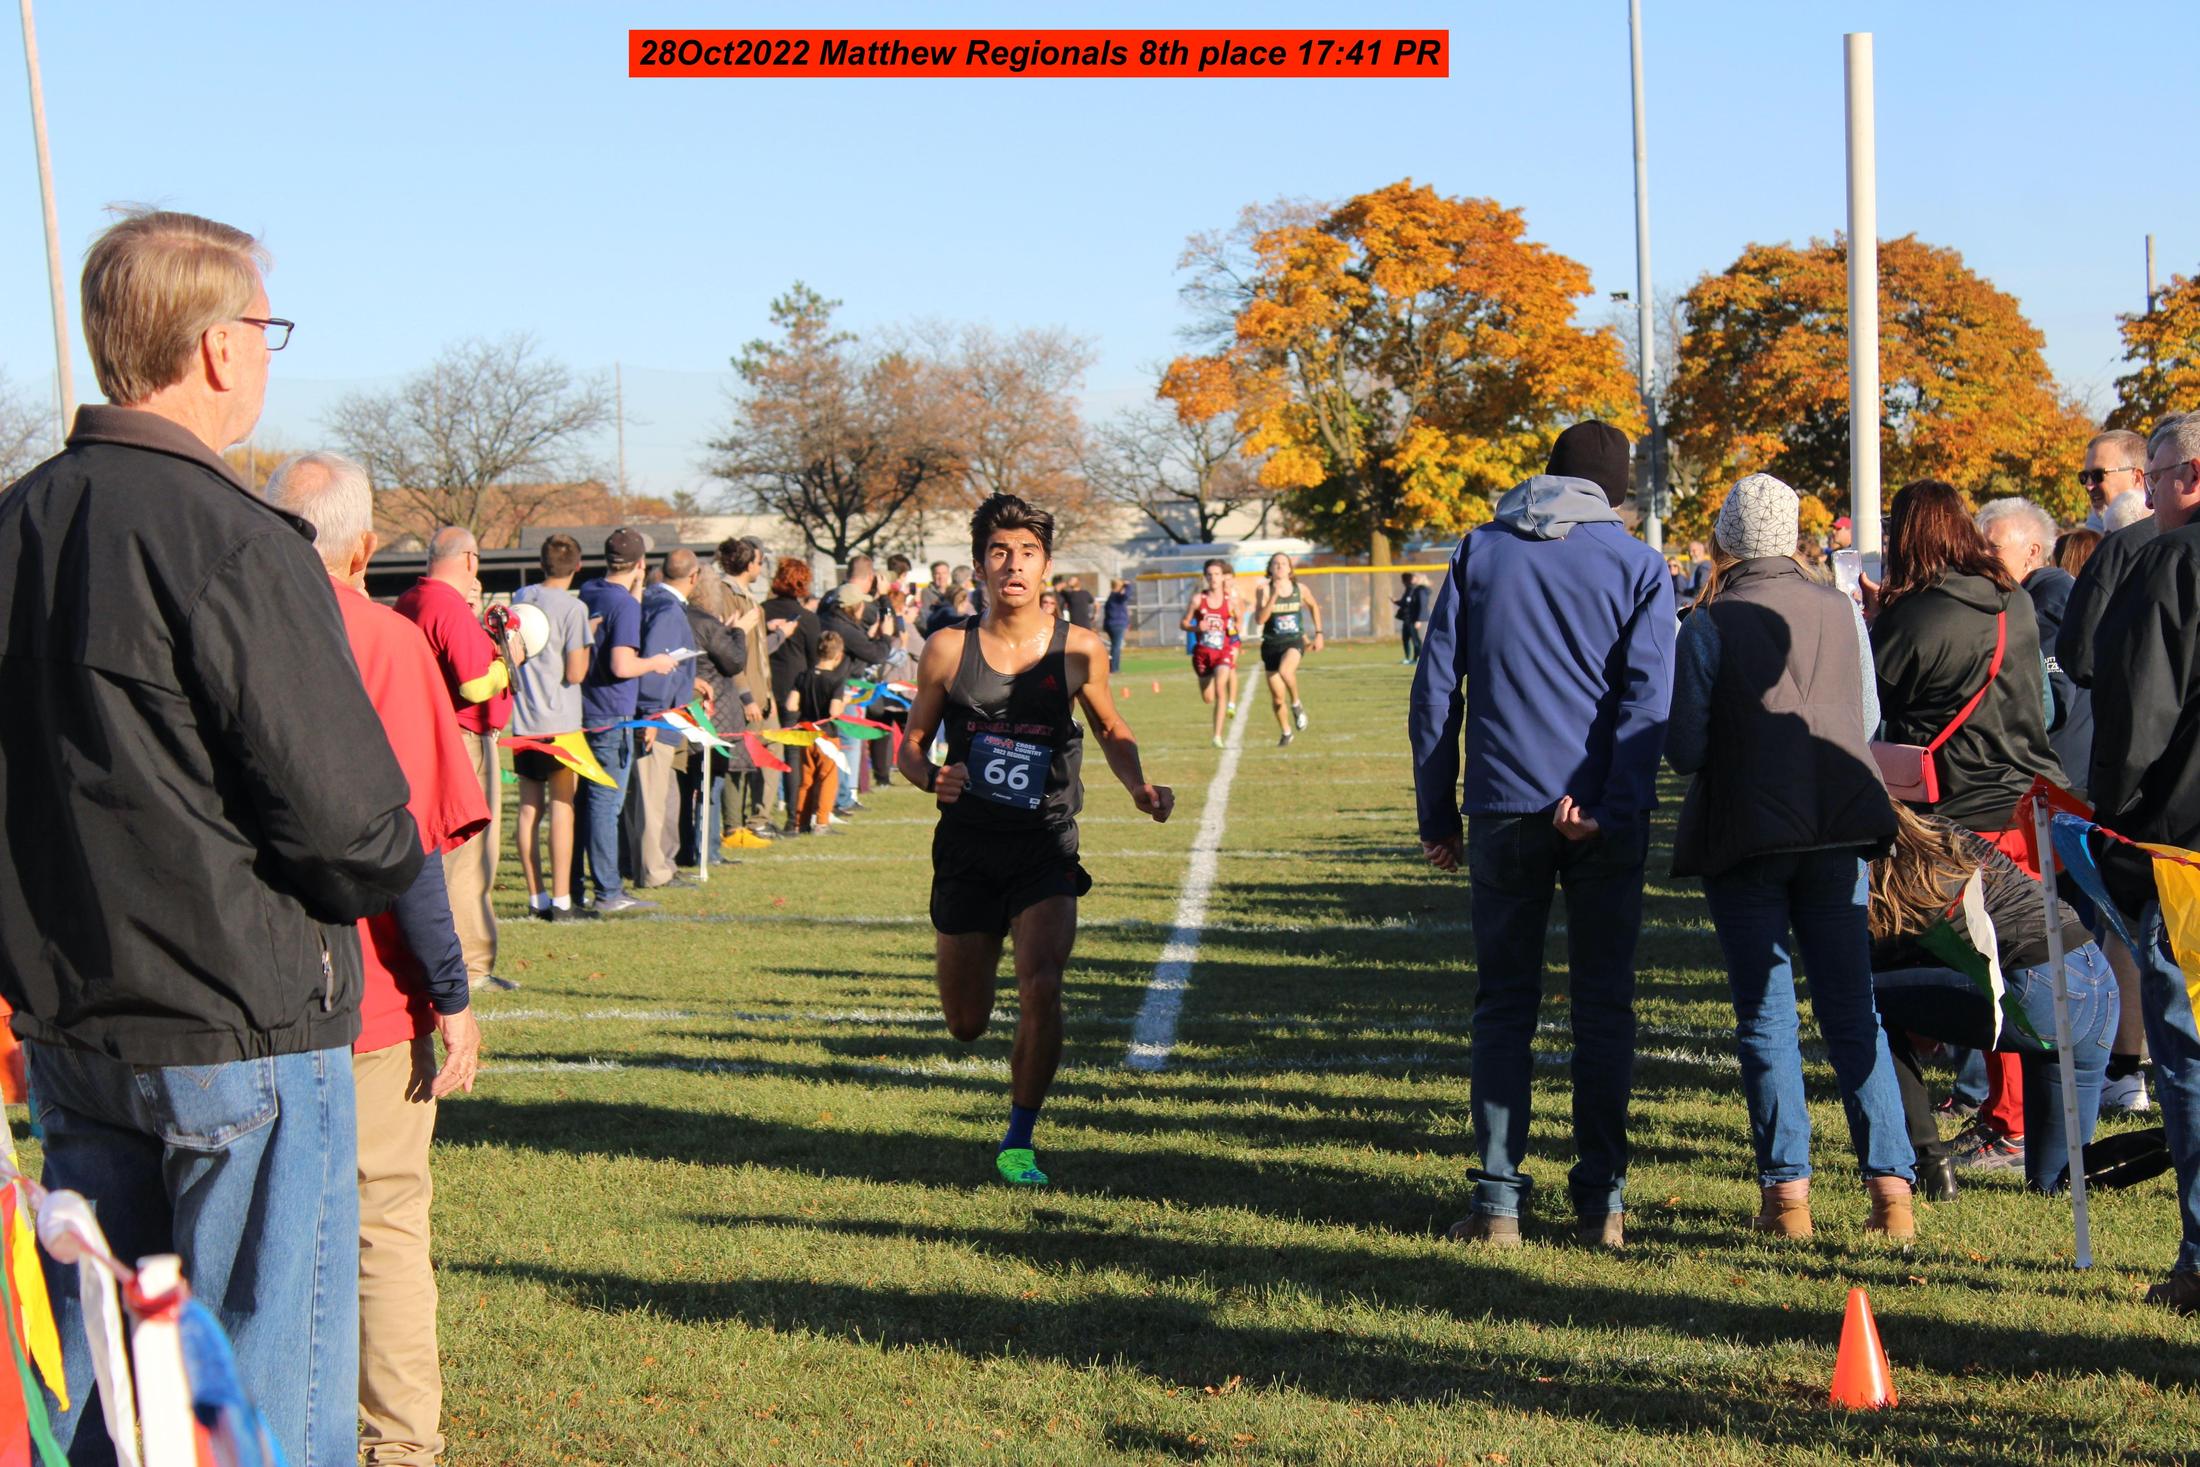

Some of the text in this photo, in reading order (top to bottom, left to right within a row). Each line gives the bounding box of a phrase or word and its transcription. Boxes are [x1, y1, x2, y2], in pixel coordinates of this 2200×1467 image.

[1016, 742, 1036, 751] CROSS
[993, 747, 1006, 756] 2022
[1014, 747, 1042, 756] COUNTRY
[984, 758, 1029, 790] 66
